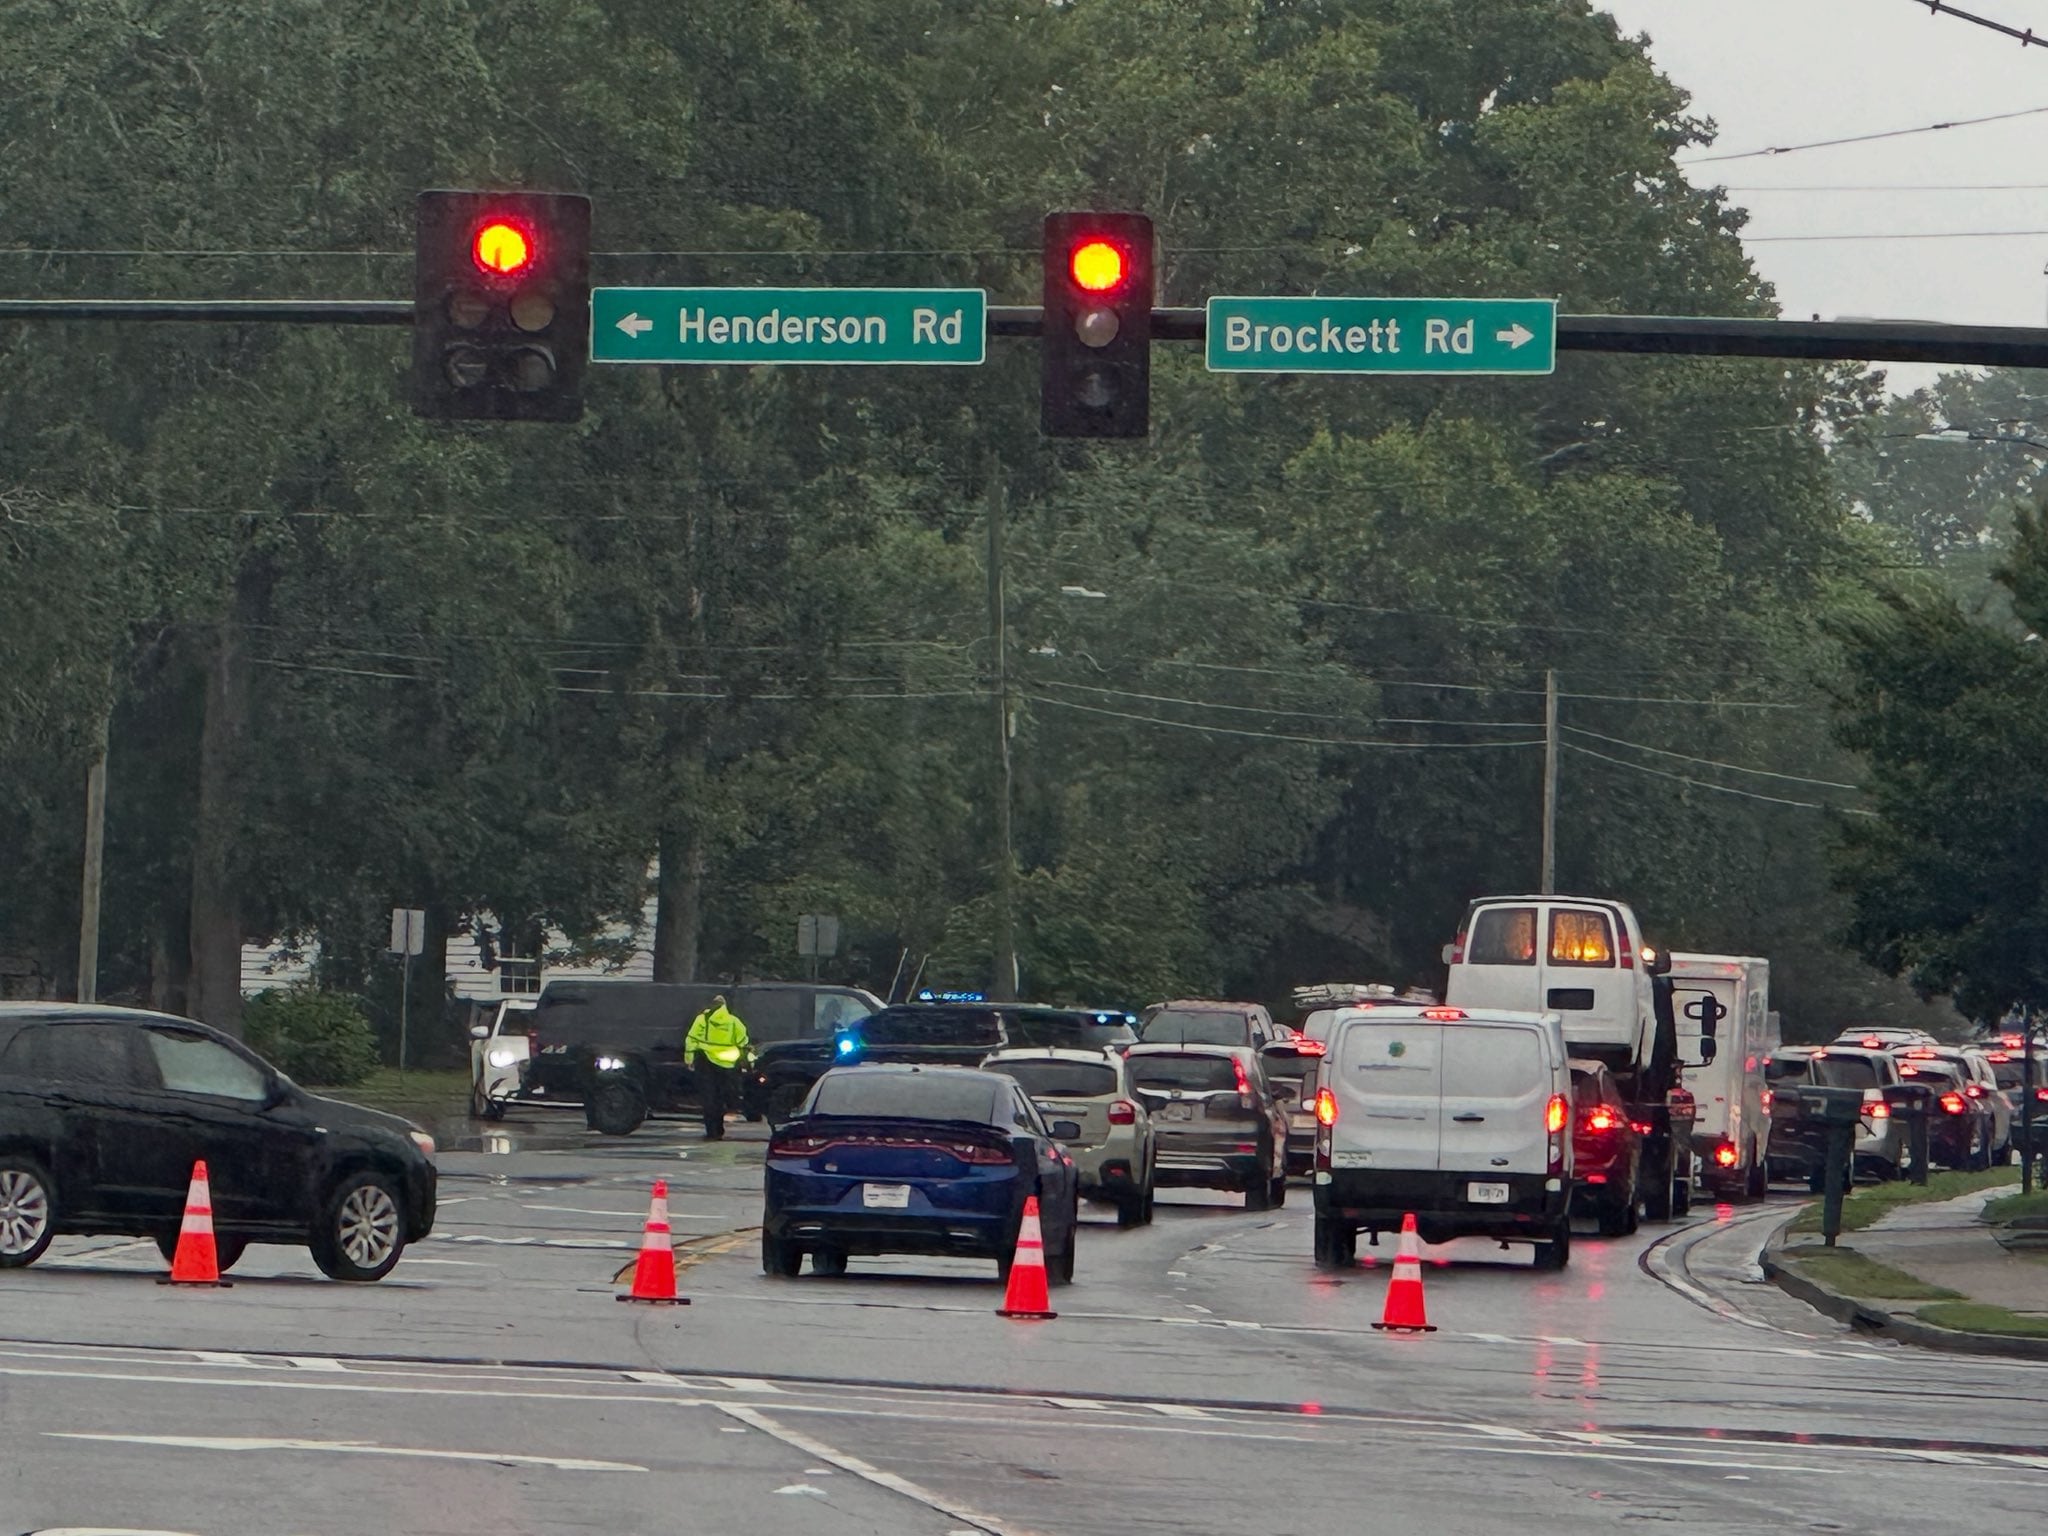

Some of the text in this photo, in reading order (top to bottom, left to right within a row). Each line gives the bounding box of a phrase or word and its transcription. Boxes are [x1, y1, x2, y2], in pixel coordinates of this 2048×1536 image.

[679, 307, 964, 345] Henderson Rd
[1225, 316, 1475, 355] Brockett Rd
